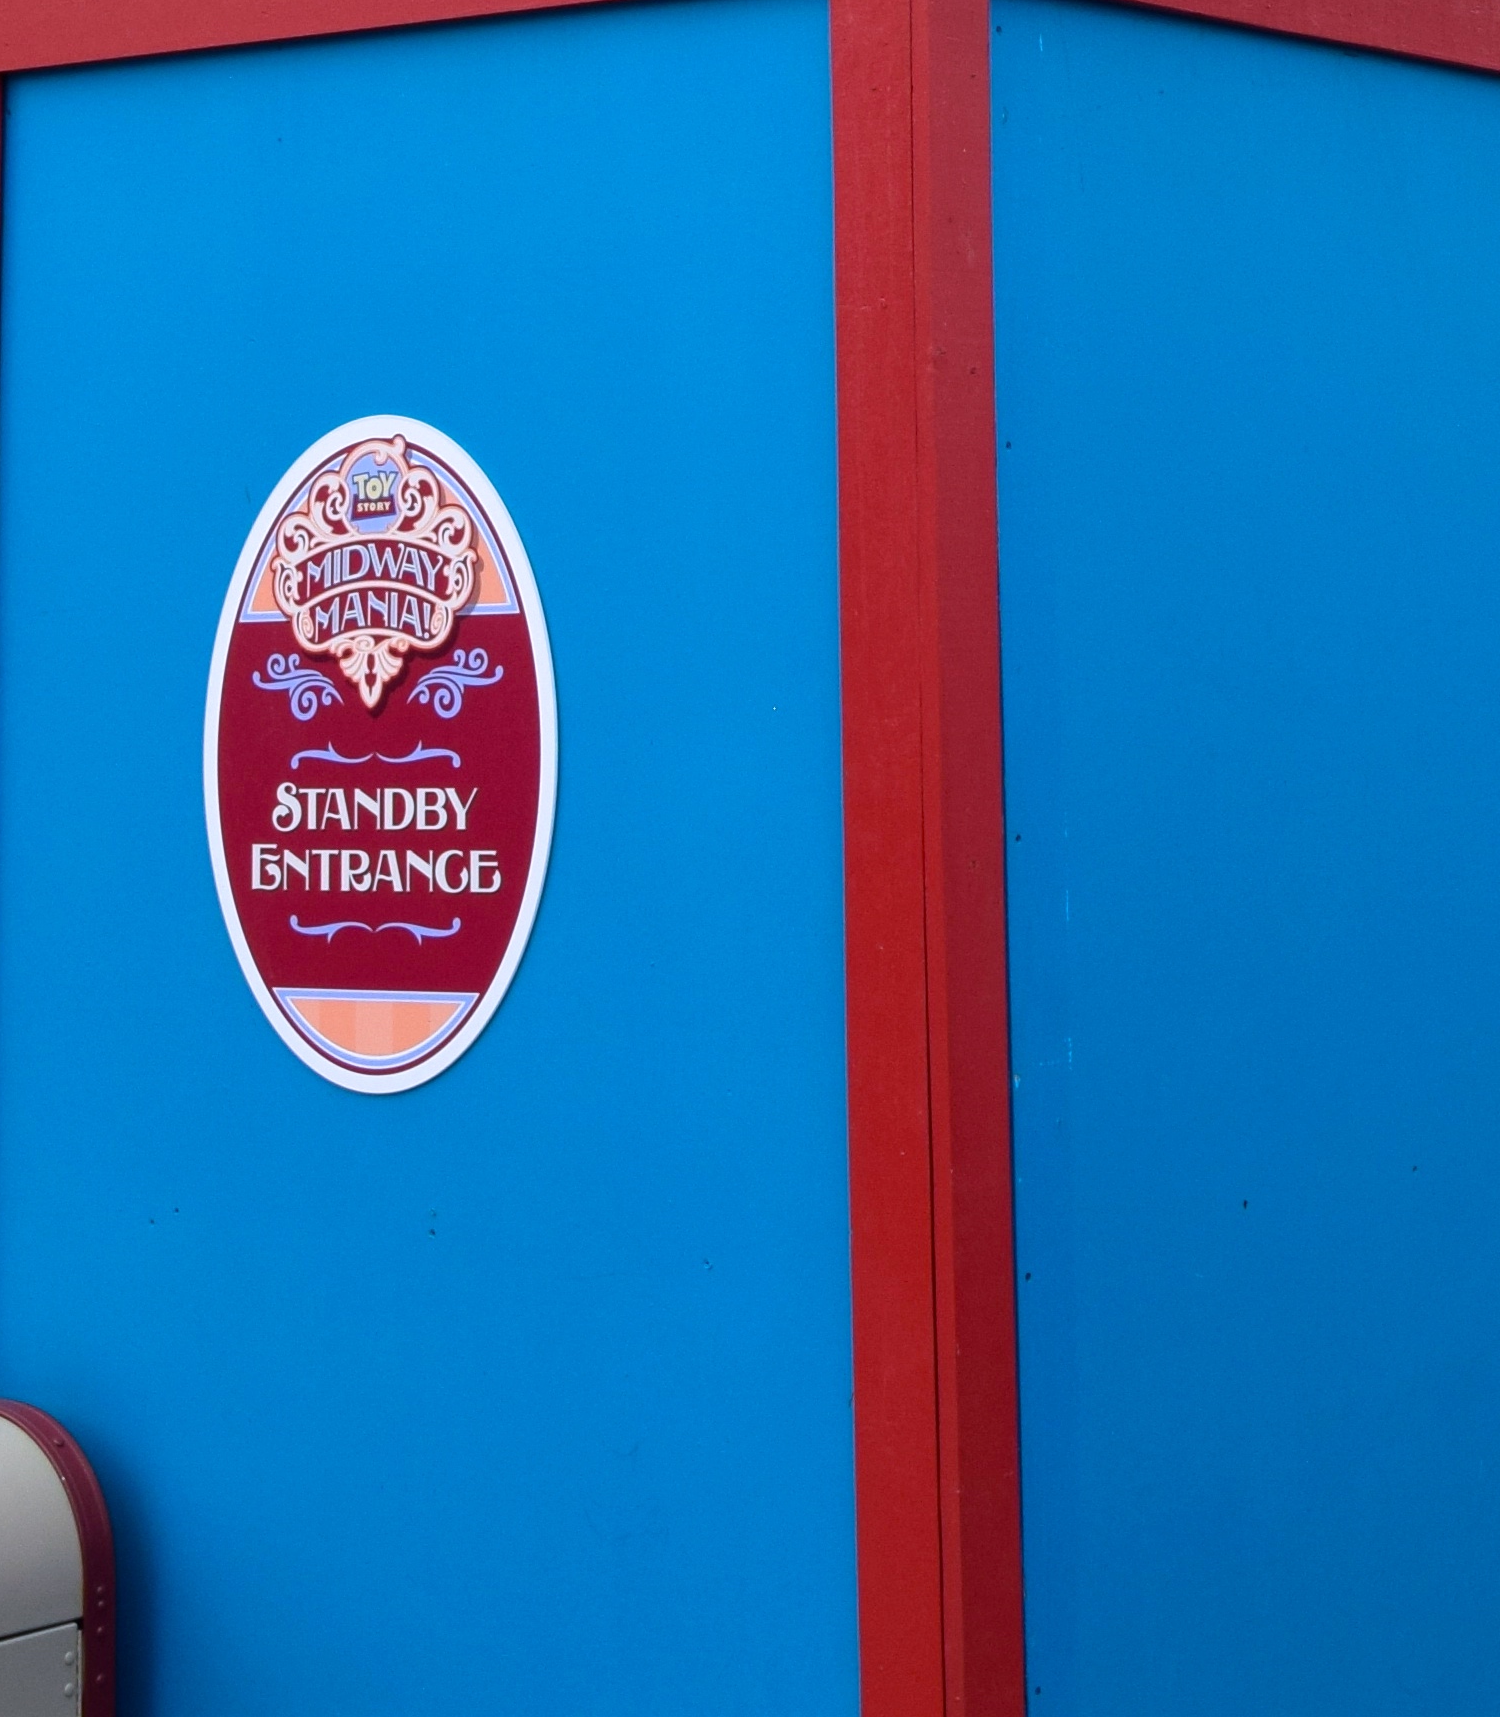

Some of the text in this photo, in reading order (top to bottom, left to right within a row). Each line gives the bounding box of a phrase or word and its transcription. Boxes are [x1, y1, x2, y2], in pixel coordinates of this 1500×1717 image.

[352, 470, 398, 501] TOY
[356, 501, 391, 513] STORY
[306, 543, 442, 597] MIDWAY
[314, 591, 431, 642] MANIA!
[271, 782, 479, 832] STANDBY
[251, 843, 501, 894] ENTRANCE
